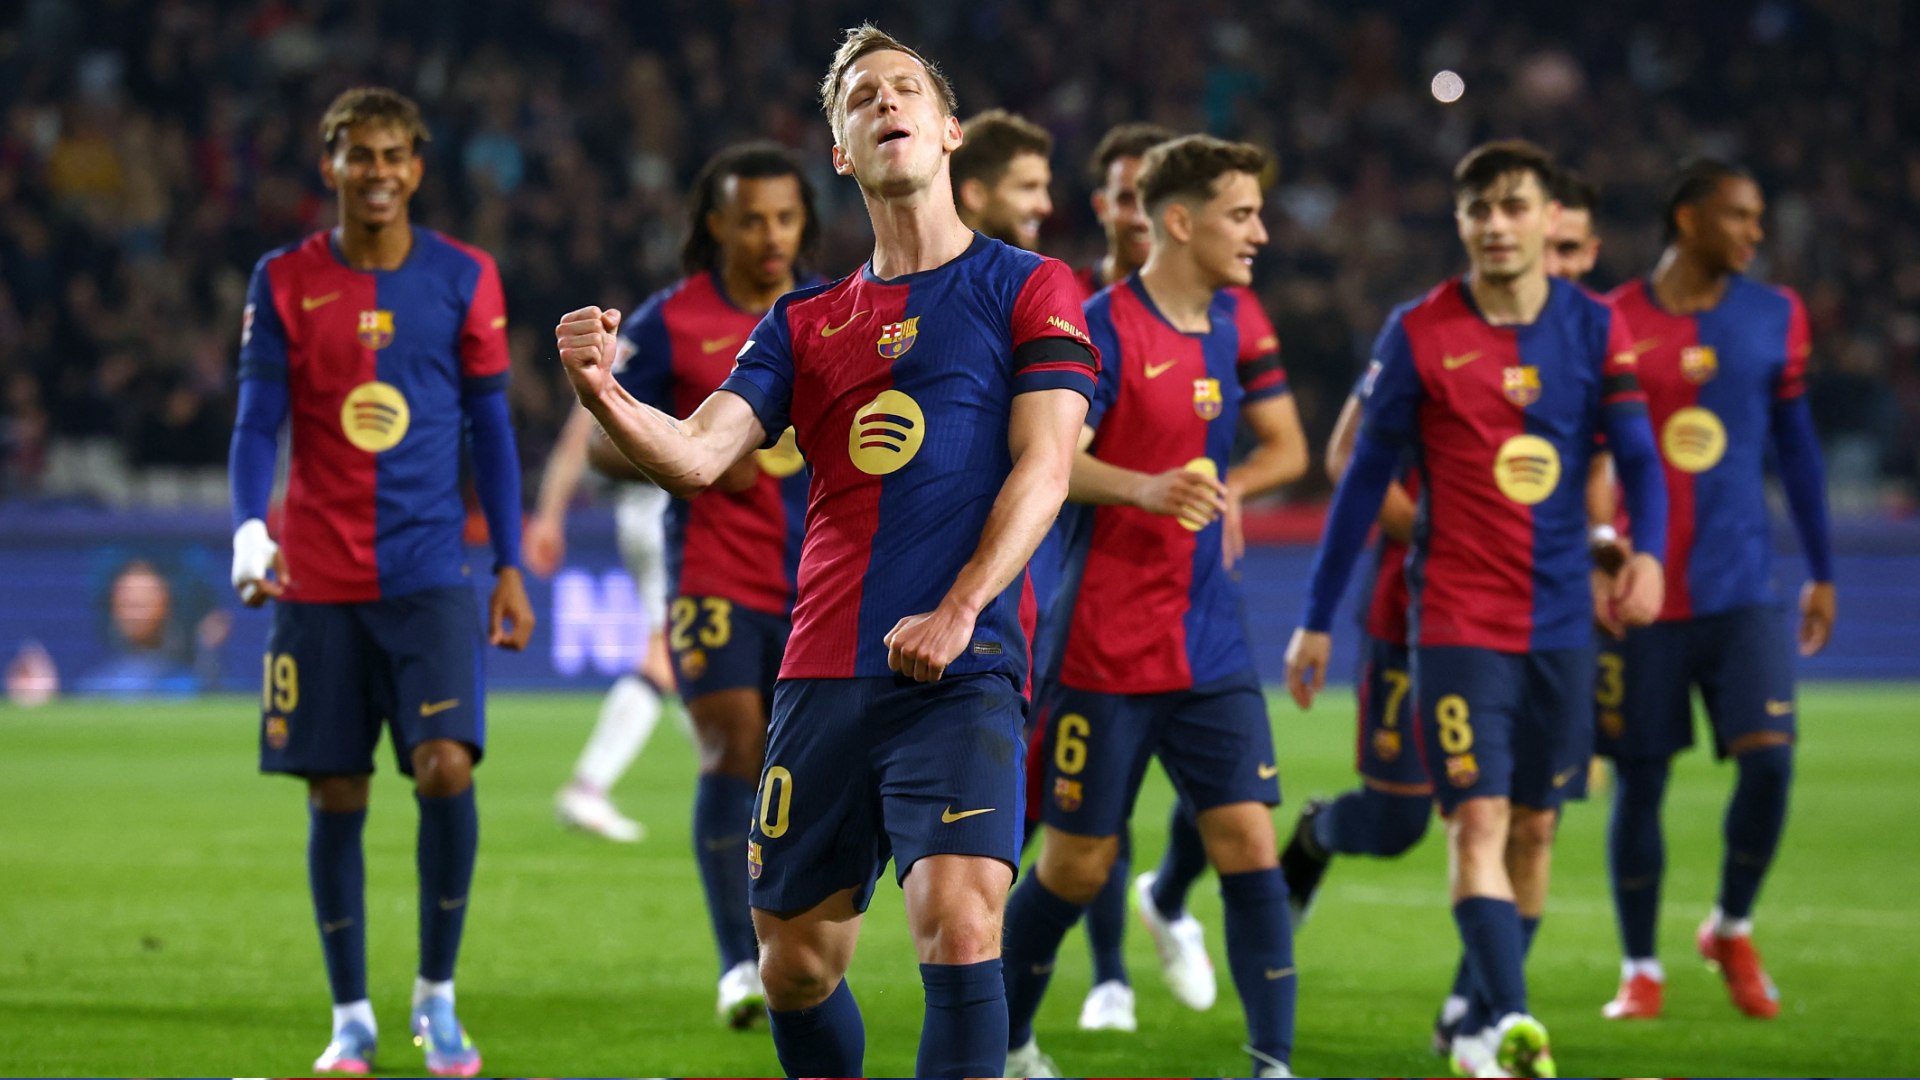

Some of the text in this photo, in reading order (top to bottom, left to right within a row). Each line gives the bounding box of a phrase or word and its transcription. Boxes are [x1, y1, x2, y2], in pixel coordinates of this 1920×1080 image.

[670, 595, 732, 649] 23
[263, 651, 298, 713] 19
[1383, 669, 1410, 727] 7
[1055, 712, 1091, 775] 6
[1435, 693, 1474, 754] 8
[751, 766, 792, 838] 0
